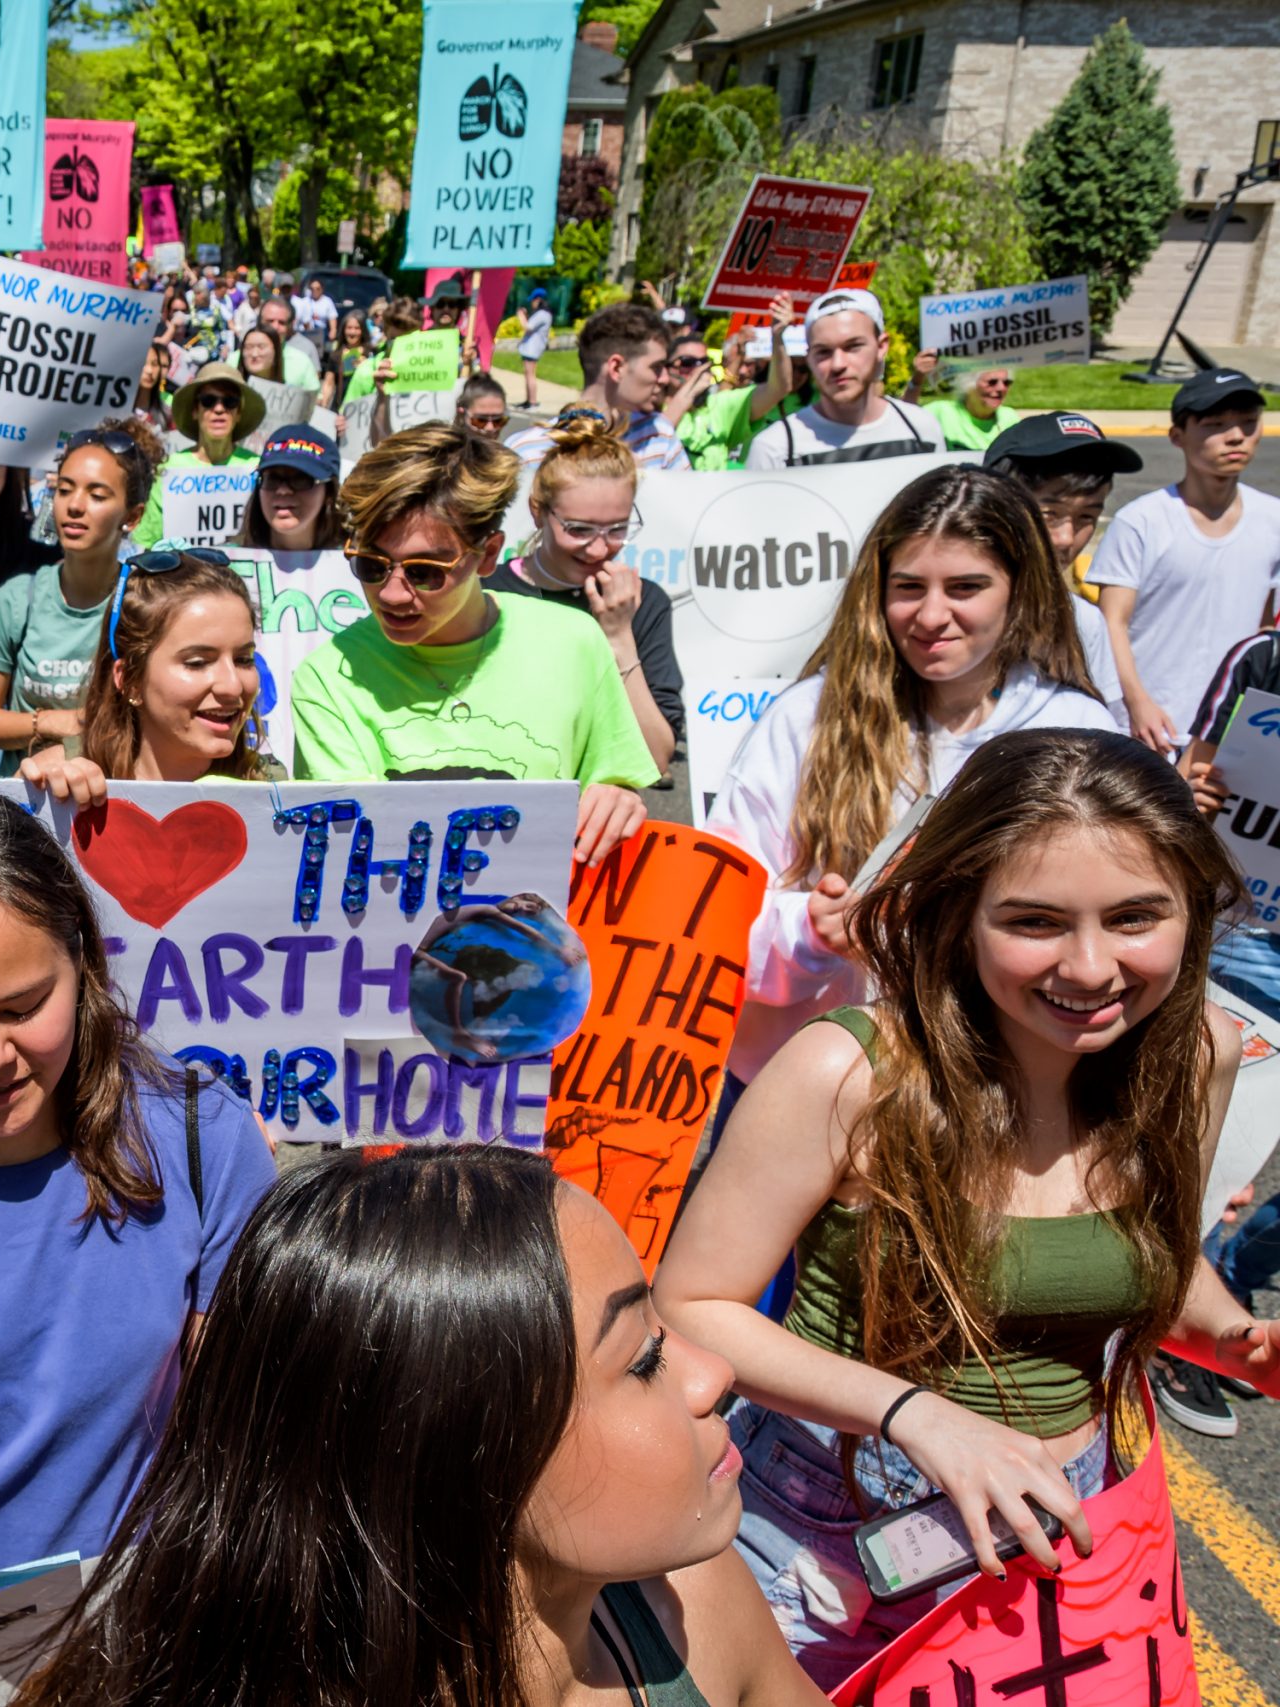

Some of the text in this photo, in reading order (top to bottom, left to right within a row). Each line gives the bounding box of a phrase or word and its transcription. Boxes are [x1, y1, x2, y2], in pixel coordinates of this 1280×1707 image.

[437, 36, 563, 53] Governor Murphy
[465, 148, 512, 181] NO
[436, 186, 534, 211] POWER
[57, 208, 92, 229] NO
[50, 240, 123, 251] adowlands
[433, 224, 532, 250] PLANT!
[726, 215, 776, 275] NO
[40, 258, 112, 277] POWER
[47, 285, 153, 326] MURPHY:
[926, 293, 1006, 316] GOVERNOR
[937, 320, 1085, 358] UEL PROJECTS
[950, 308, 1055, 342] NO FOSSIL
[409, 356, 435, 366] OUR
[419, 340, 444, 351] THIS
[198, 505, 226, 532] NO
[693, 531, 850, 591] watch
[229, 560, 367, 635] he
[272, 799, 520, 924] THE
[104, 932, 411, 1033] ARTH
[602, 934, 745, 1048] THE
[344, 1046, 553, 1145] HOME
